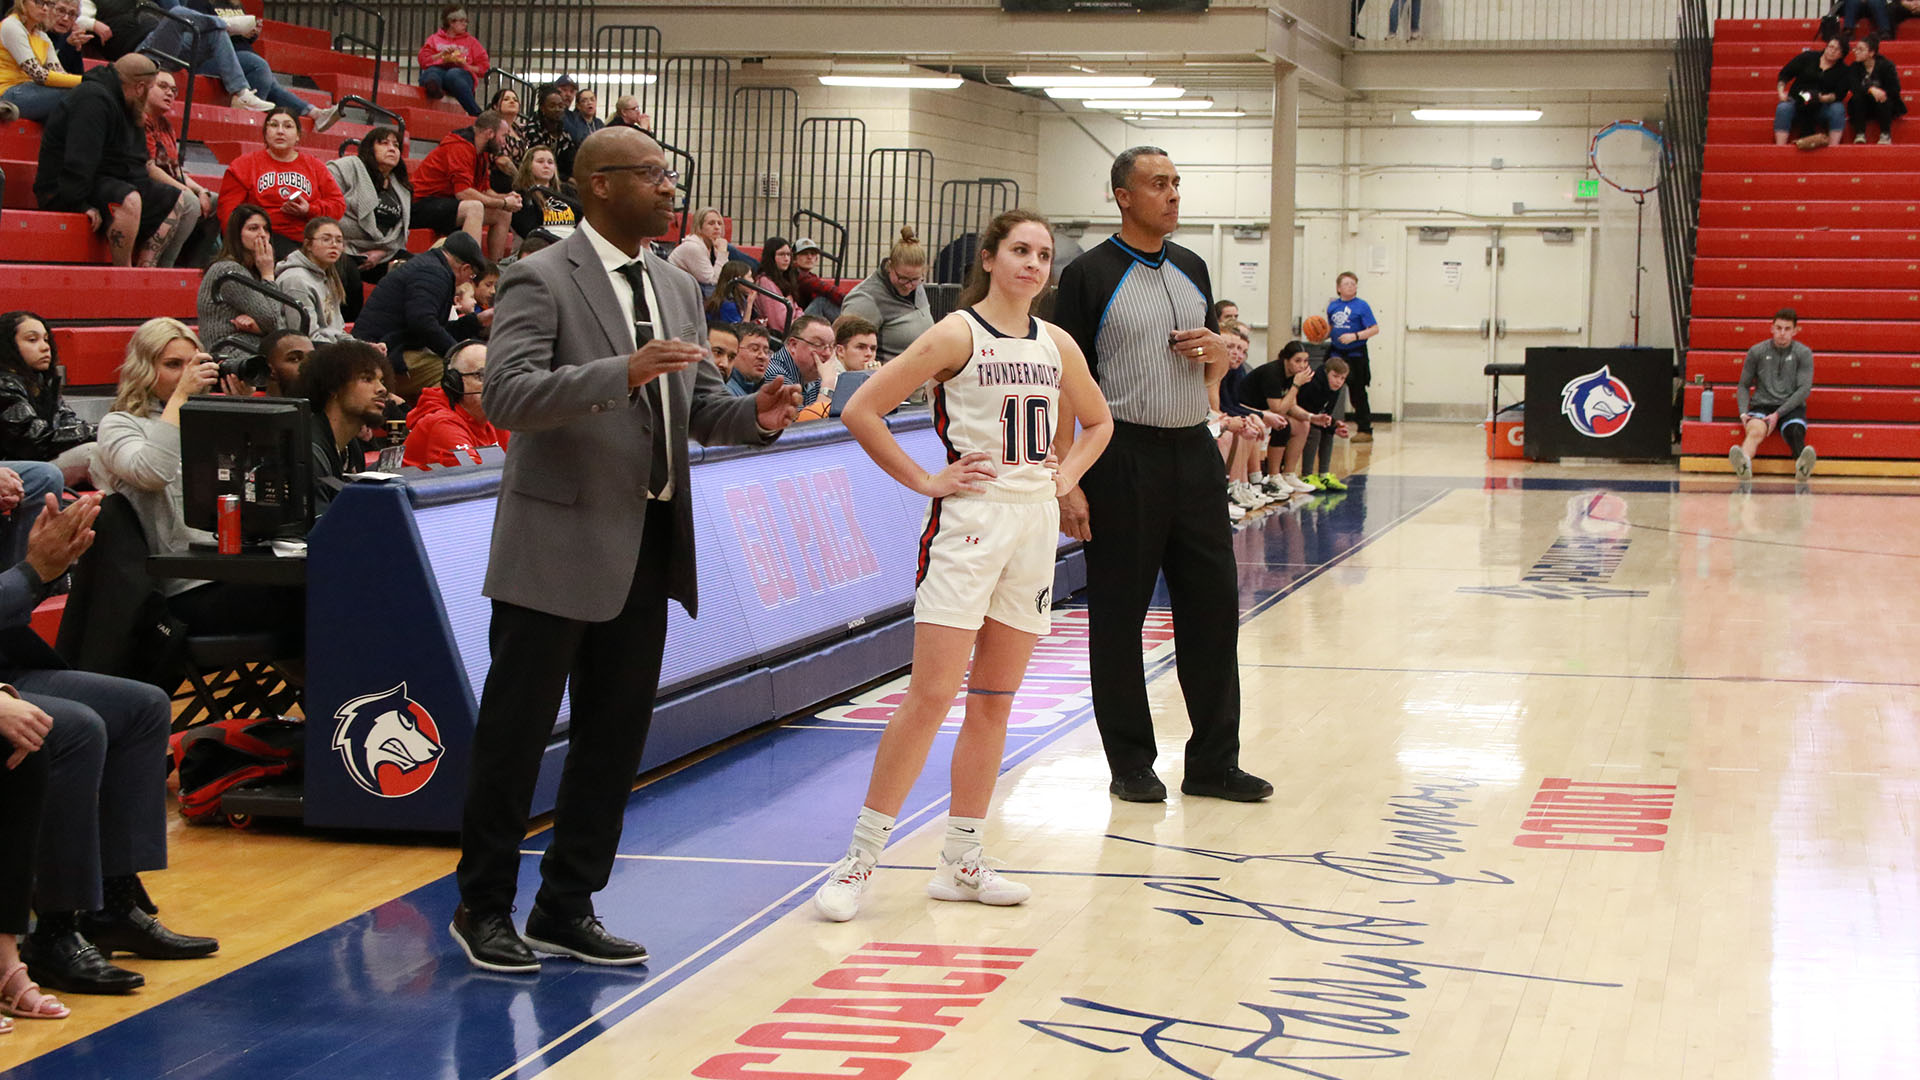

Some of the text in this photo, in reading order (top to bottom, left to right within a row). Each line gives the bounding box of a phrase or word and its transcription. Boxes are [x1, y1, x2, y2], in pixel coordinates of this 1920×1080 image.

[257, 172, 312, 196] CSU PUEBLO
[977, 362, 1061, 388] THUNDERWOLVE
[999, 395, 1050, 465] 10
[1507, 426, 1525, 446] G
[723, 464, 881, 611] GO PACK
[1513, 777, 1676, 852] COURT
[691, 942, 1039, 1080] COACH
